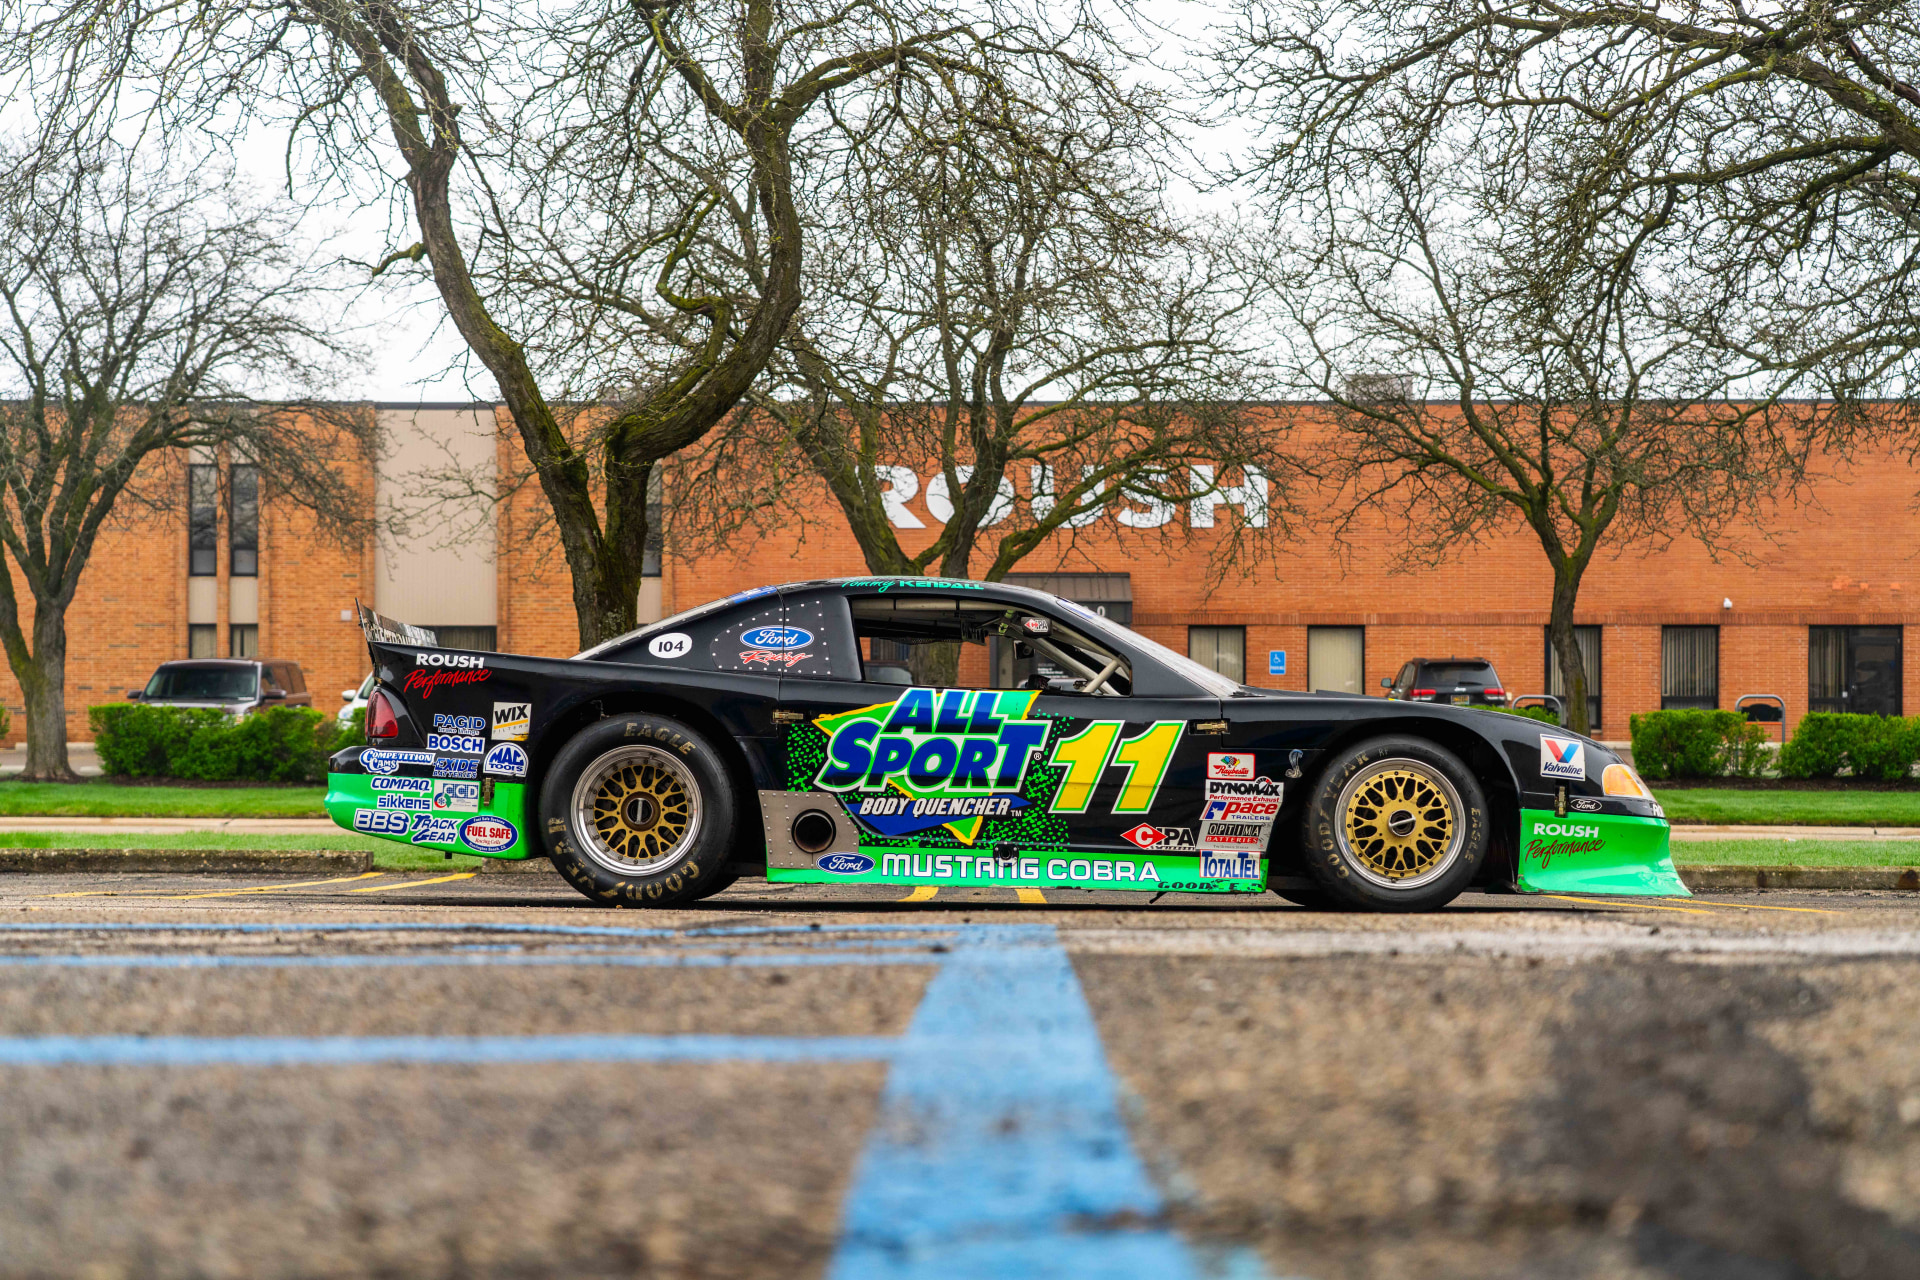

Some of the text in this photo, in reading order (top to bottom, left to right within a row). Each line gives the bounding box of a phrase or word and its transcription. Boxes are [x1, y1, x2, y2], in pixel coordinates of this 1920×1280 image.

[856, 465, 1269, 528] ROUSH
[841, 580, 984, 593] Tommy KENDALL
[755, 629, 798, 645] Ford
[658, 640, 684, 652] 104
[416, 653, 485, 669] ROUSH
[739, 650, 813, 667] Racing
[404, 669, 492, 699] Performance
[494, 705, 528, 724] WIX
[880, 688, 1007, 735] ALL
[433, 713, 486, 730] PAGID
[428, 735, 484, 753] BOSCH
[623, 722, 697, 755] EAGLE
[360, 748, 433, 763] COMPETITION
[489, 747, 524, 766] MAC
[814, 717, 1052, 793] SPORT
[368, 757, 397, 772] CAMS
[434, 758, 480, 772] EXIDE
[1048, 720, 1187, 814] 11
[1543, 761, 1583, 775] Valvoline
[372, 778, 431, 796] COMPAQ
[443, 784, 478, 799] CCD
[1210, 782, 1280, 796] DYNOMAX
[379, 795, 430, 810] sikkens
[1209, 794, 1252, 802] Performance
[1575, 800, 1596, 810] Ford
[859, 798, 914, 816] BODY
[912, 797, 1012, 817] QUENCHER
[1221, 802, 1278, 820] pace
[355, 809, 410, 835] BBS
[411, 814, 458, 830] TRACK
[1208, 823, 1261, 836] OPTIMA
[412, 829, 457, 843] GEAR
[466, 825, 512, 840] FUEL SAFE
[1134, 826, 1196, 847] CIPA
[1533, 823, 1600, 838] ROUSH
[1206, 836, 1259, 844] BATTERIES
[1524, 838, 1606, 868] Performance
[828, 855, 864, 873] Ford
[881, 852, 1162, 883] MUSTANG COBRA
